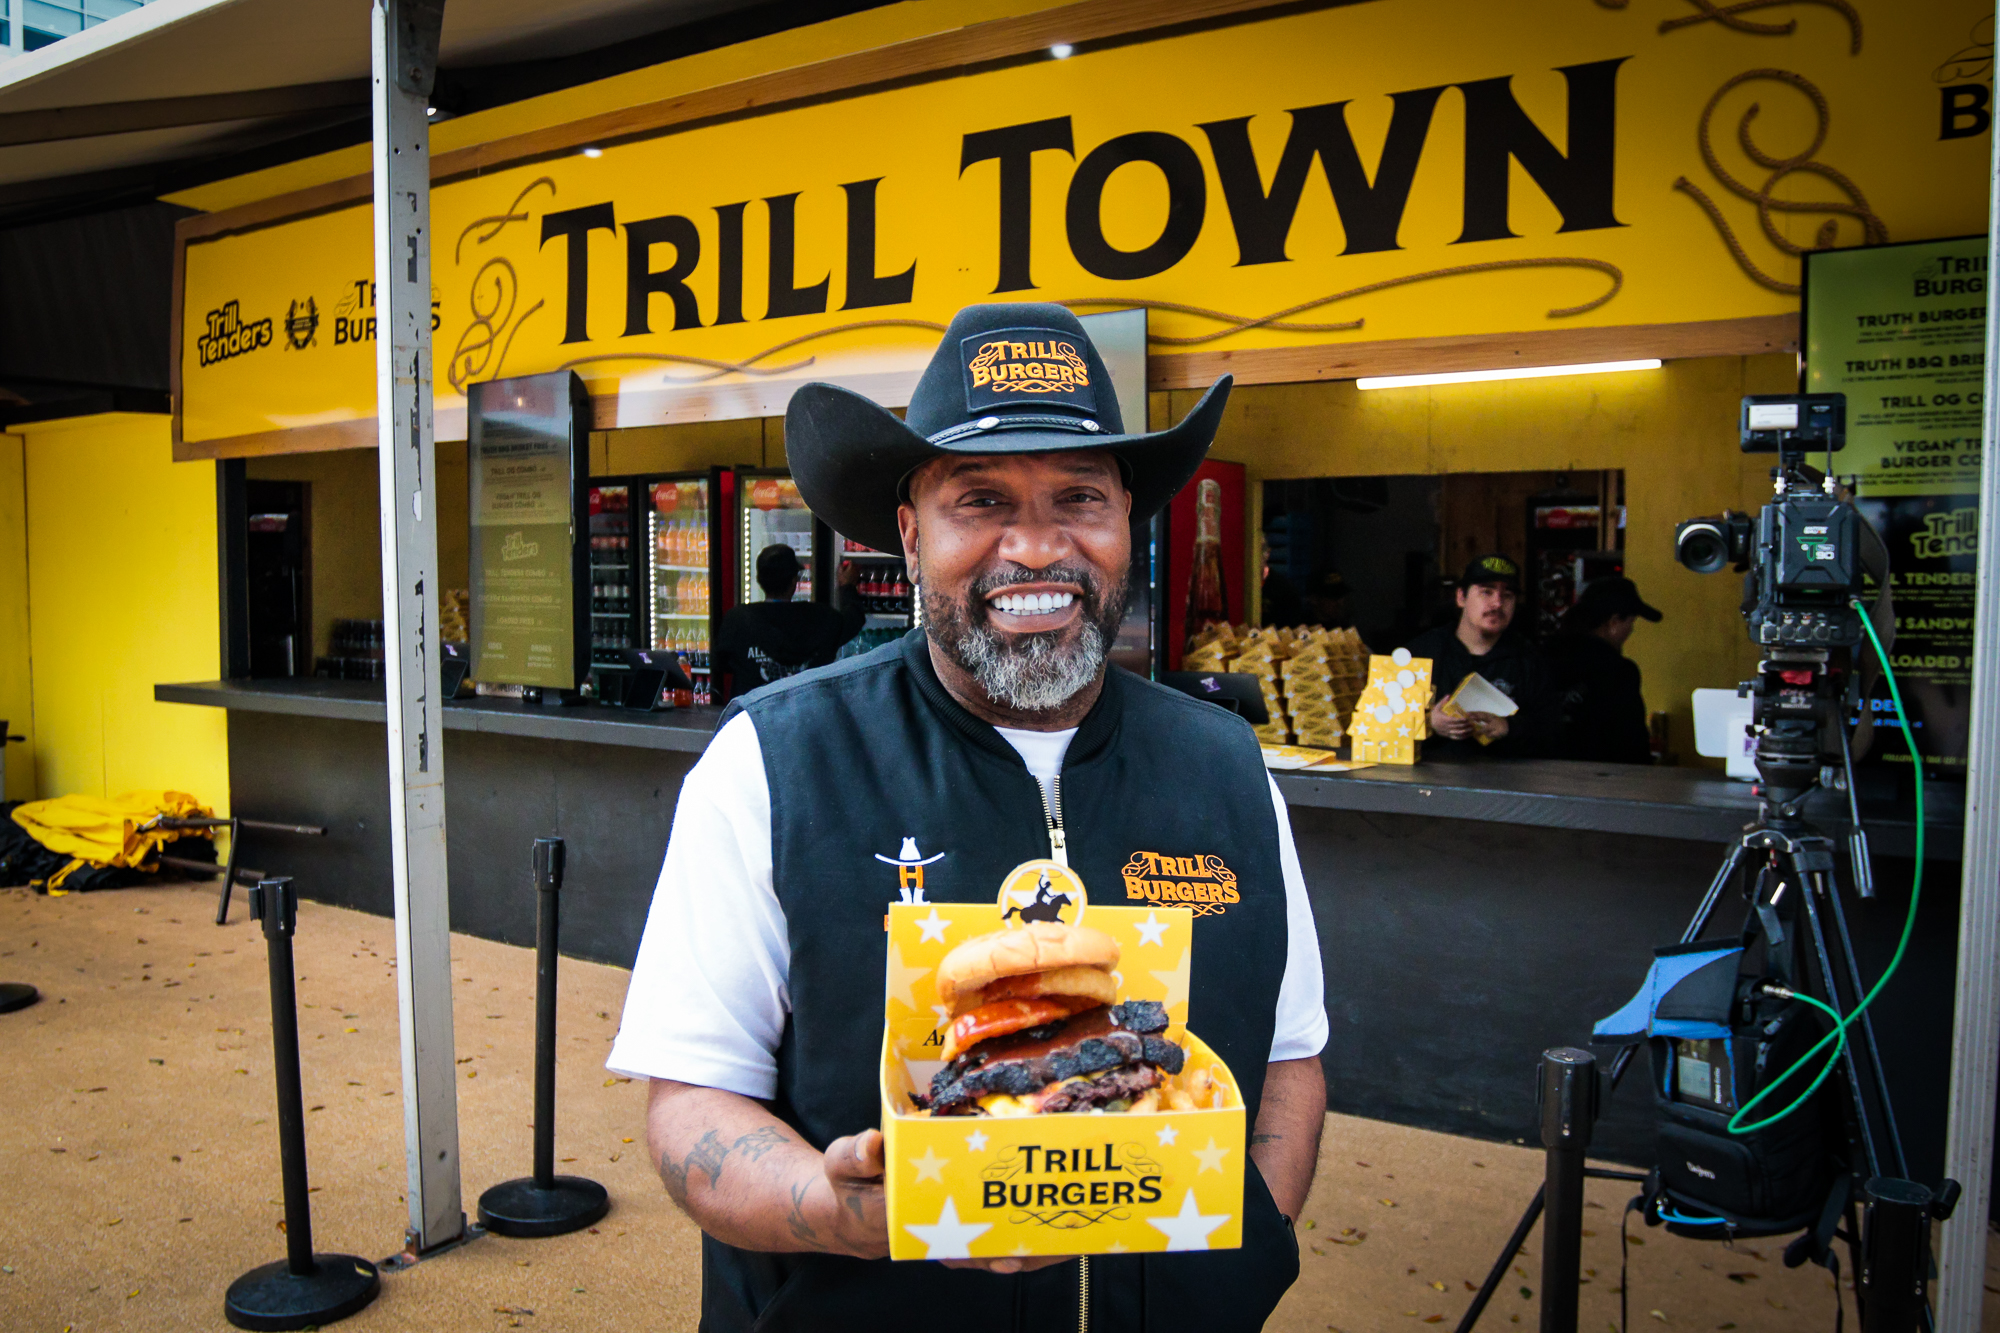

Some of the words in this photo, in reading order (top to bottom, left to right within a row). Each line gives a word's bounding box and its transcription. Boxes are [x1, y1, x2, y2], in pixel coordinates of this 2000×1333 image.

[539, 177, 917, 346] TRILL
[958, 55, 1635, 295] TOWN
[1914, 278, 1987, 297] BURG
[207, 299, 240, 339] Trill
[1857, 312, 1913, 328] TRUTH
[197, 317, 273, 368] Tenders
[990, 341, 1065, 361] TRILL
[972, 362, 1090, 388] BURGERS
[1845, 359, 1902, 373] TRUTH
[1907, 356, 1943, 369] BBQ
[1881, 396, 1926, 408] TRILL
[1933, 394, 1961, 406] OG
[1881, 455, 1952, 468] BURGER
[1924, 508, 1978, 536] Trill
[1904, 572, 1976, 585] TENDER
[1889, 654, 1961, 668] LOADED
[1143, 851, 1213, 878] TRILL
[1123, 875, 1241, 904] BURGERS
[1018, 1143, 1123, 1174] TRILL
[982, 1175, 1162, 1209] BURGERS
